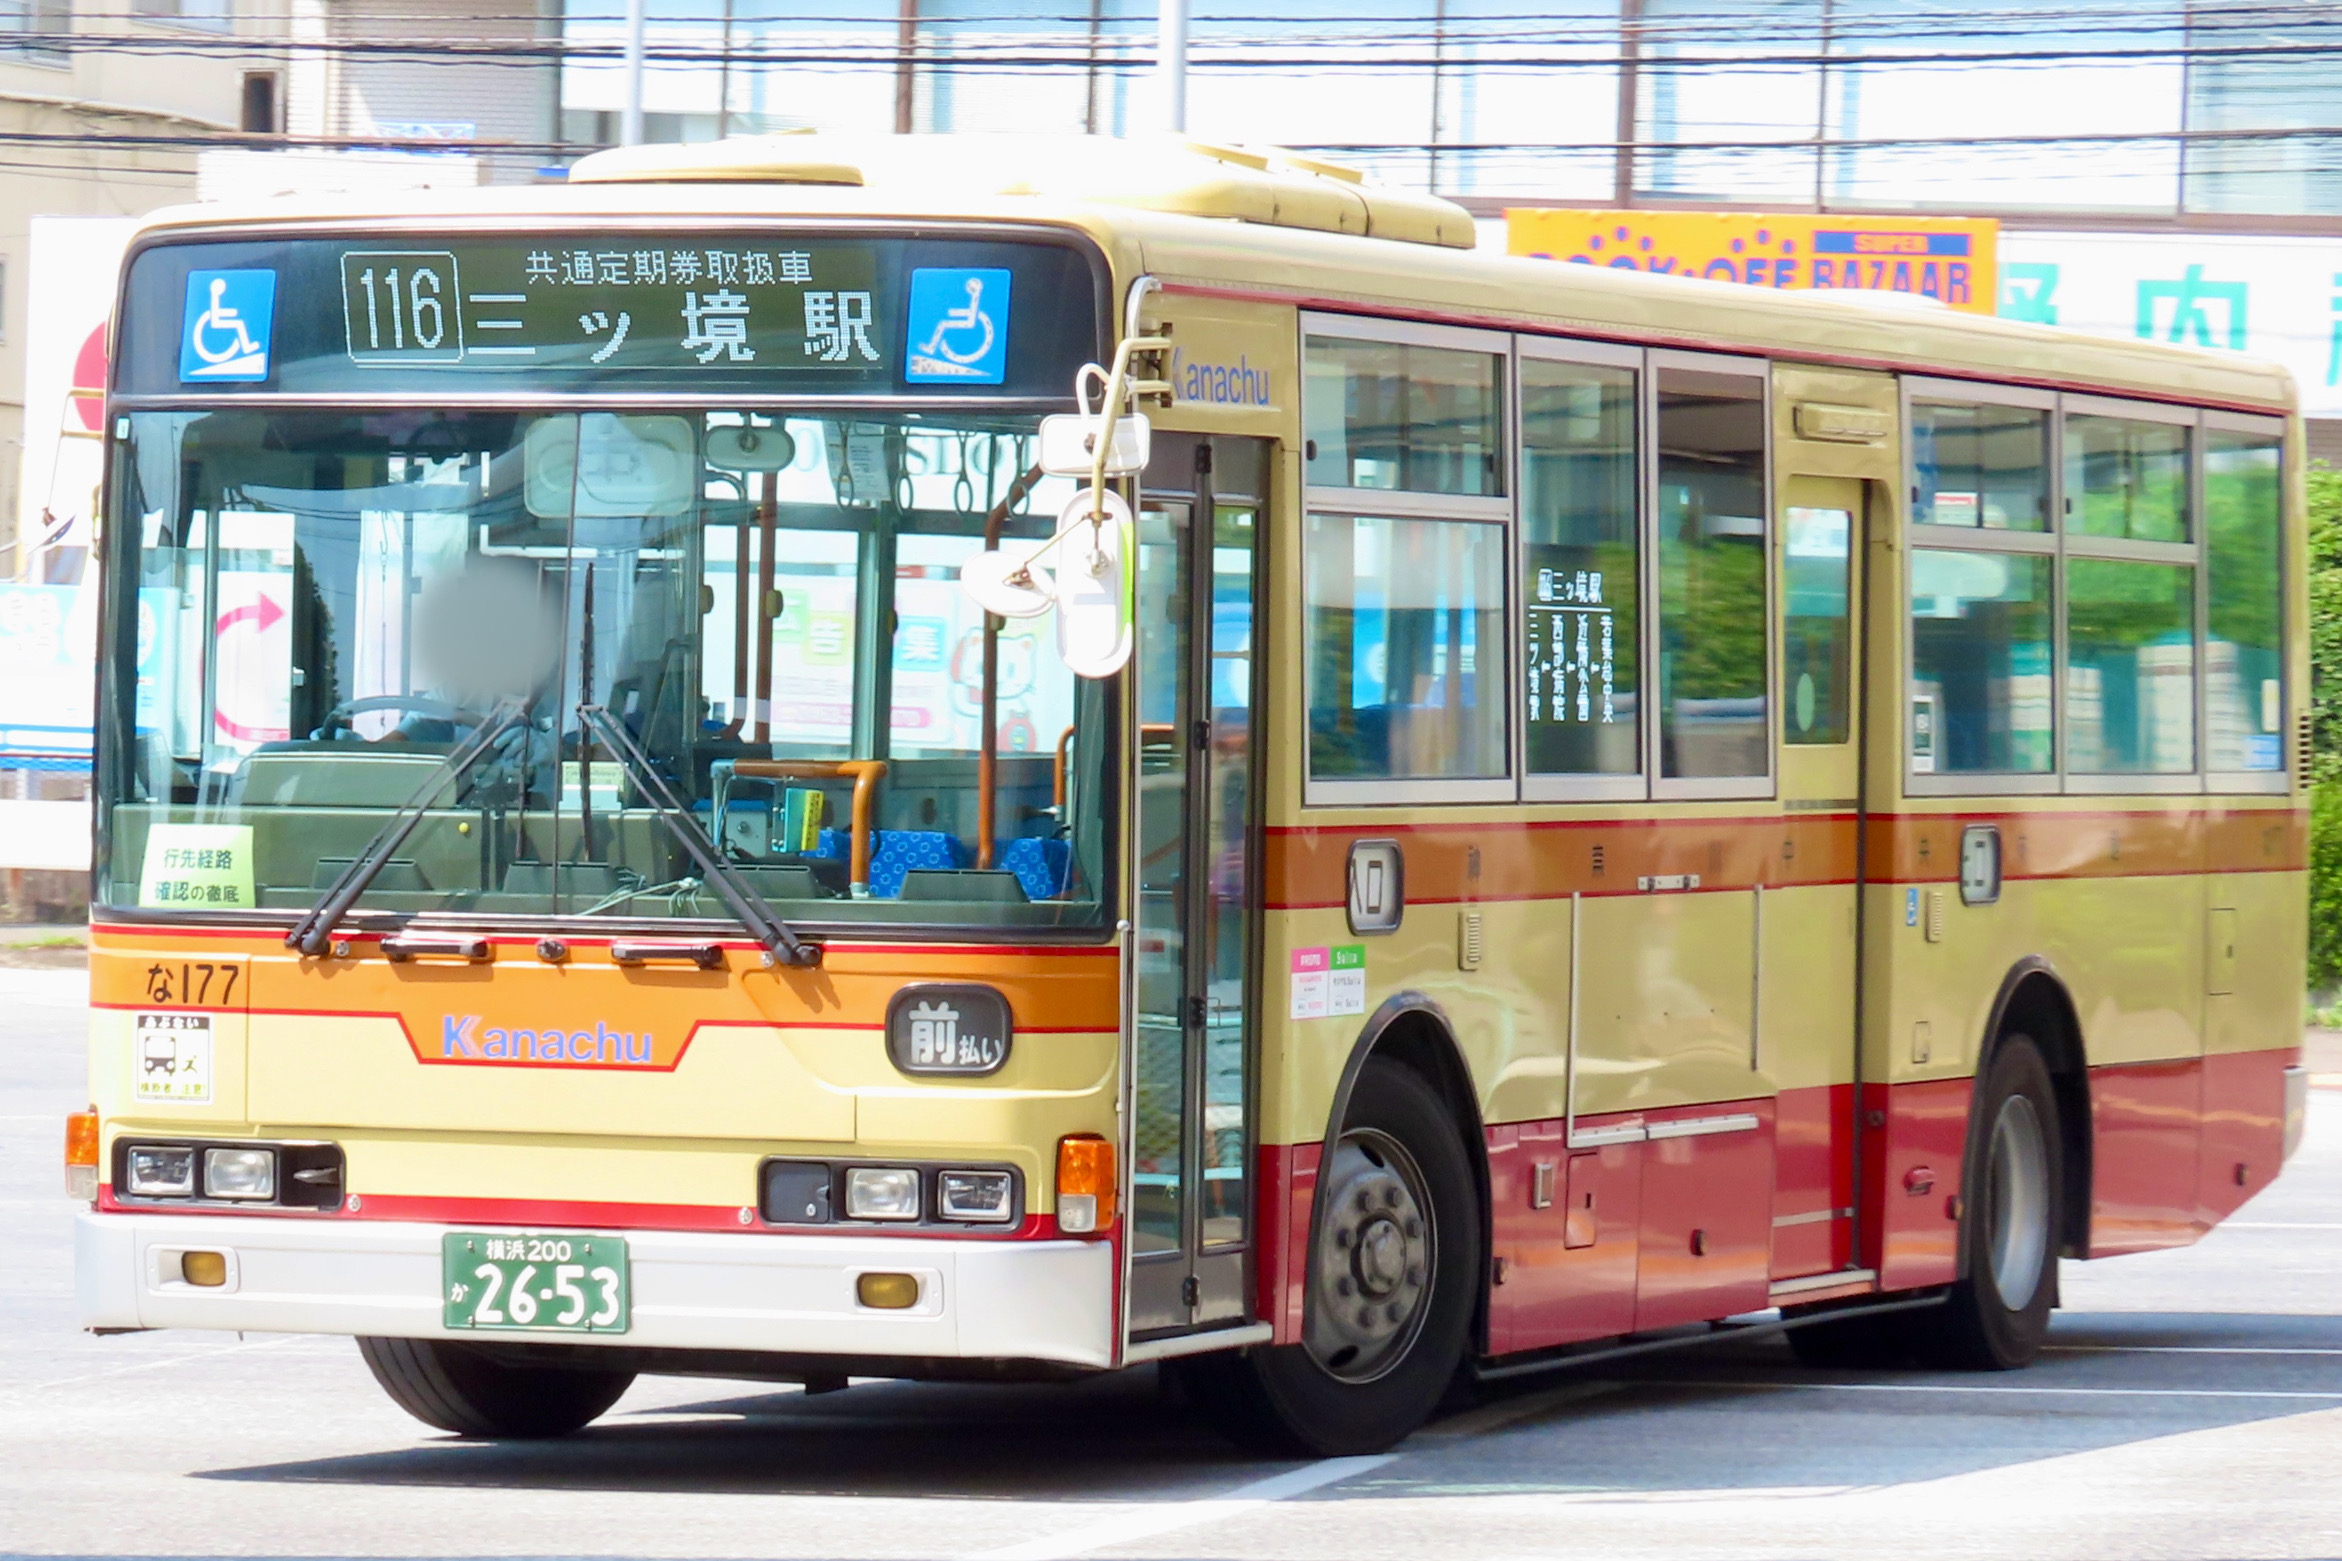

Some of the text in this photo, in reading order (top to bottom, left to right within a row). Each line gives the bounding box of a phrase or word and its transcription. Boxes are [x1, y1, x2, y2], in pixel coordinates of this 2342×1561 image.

[525, 250, 813, 286] 共通定期券取扱車
[1812, 260, 1970, 303] BAZAAR
[360, 267, 444, 349] 116
[163, 848, 233, 870] 行先経路
[155, 881, 240, 903] 確認の徹底
[146, 962, 240, 1006] な177
[443, 1014, 653, 1063] Kanachu
[451, 1262, 620, 1326] か 26-53
